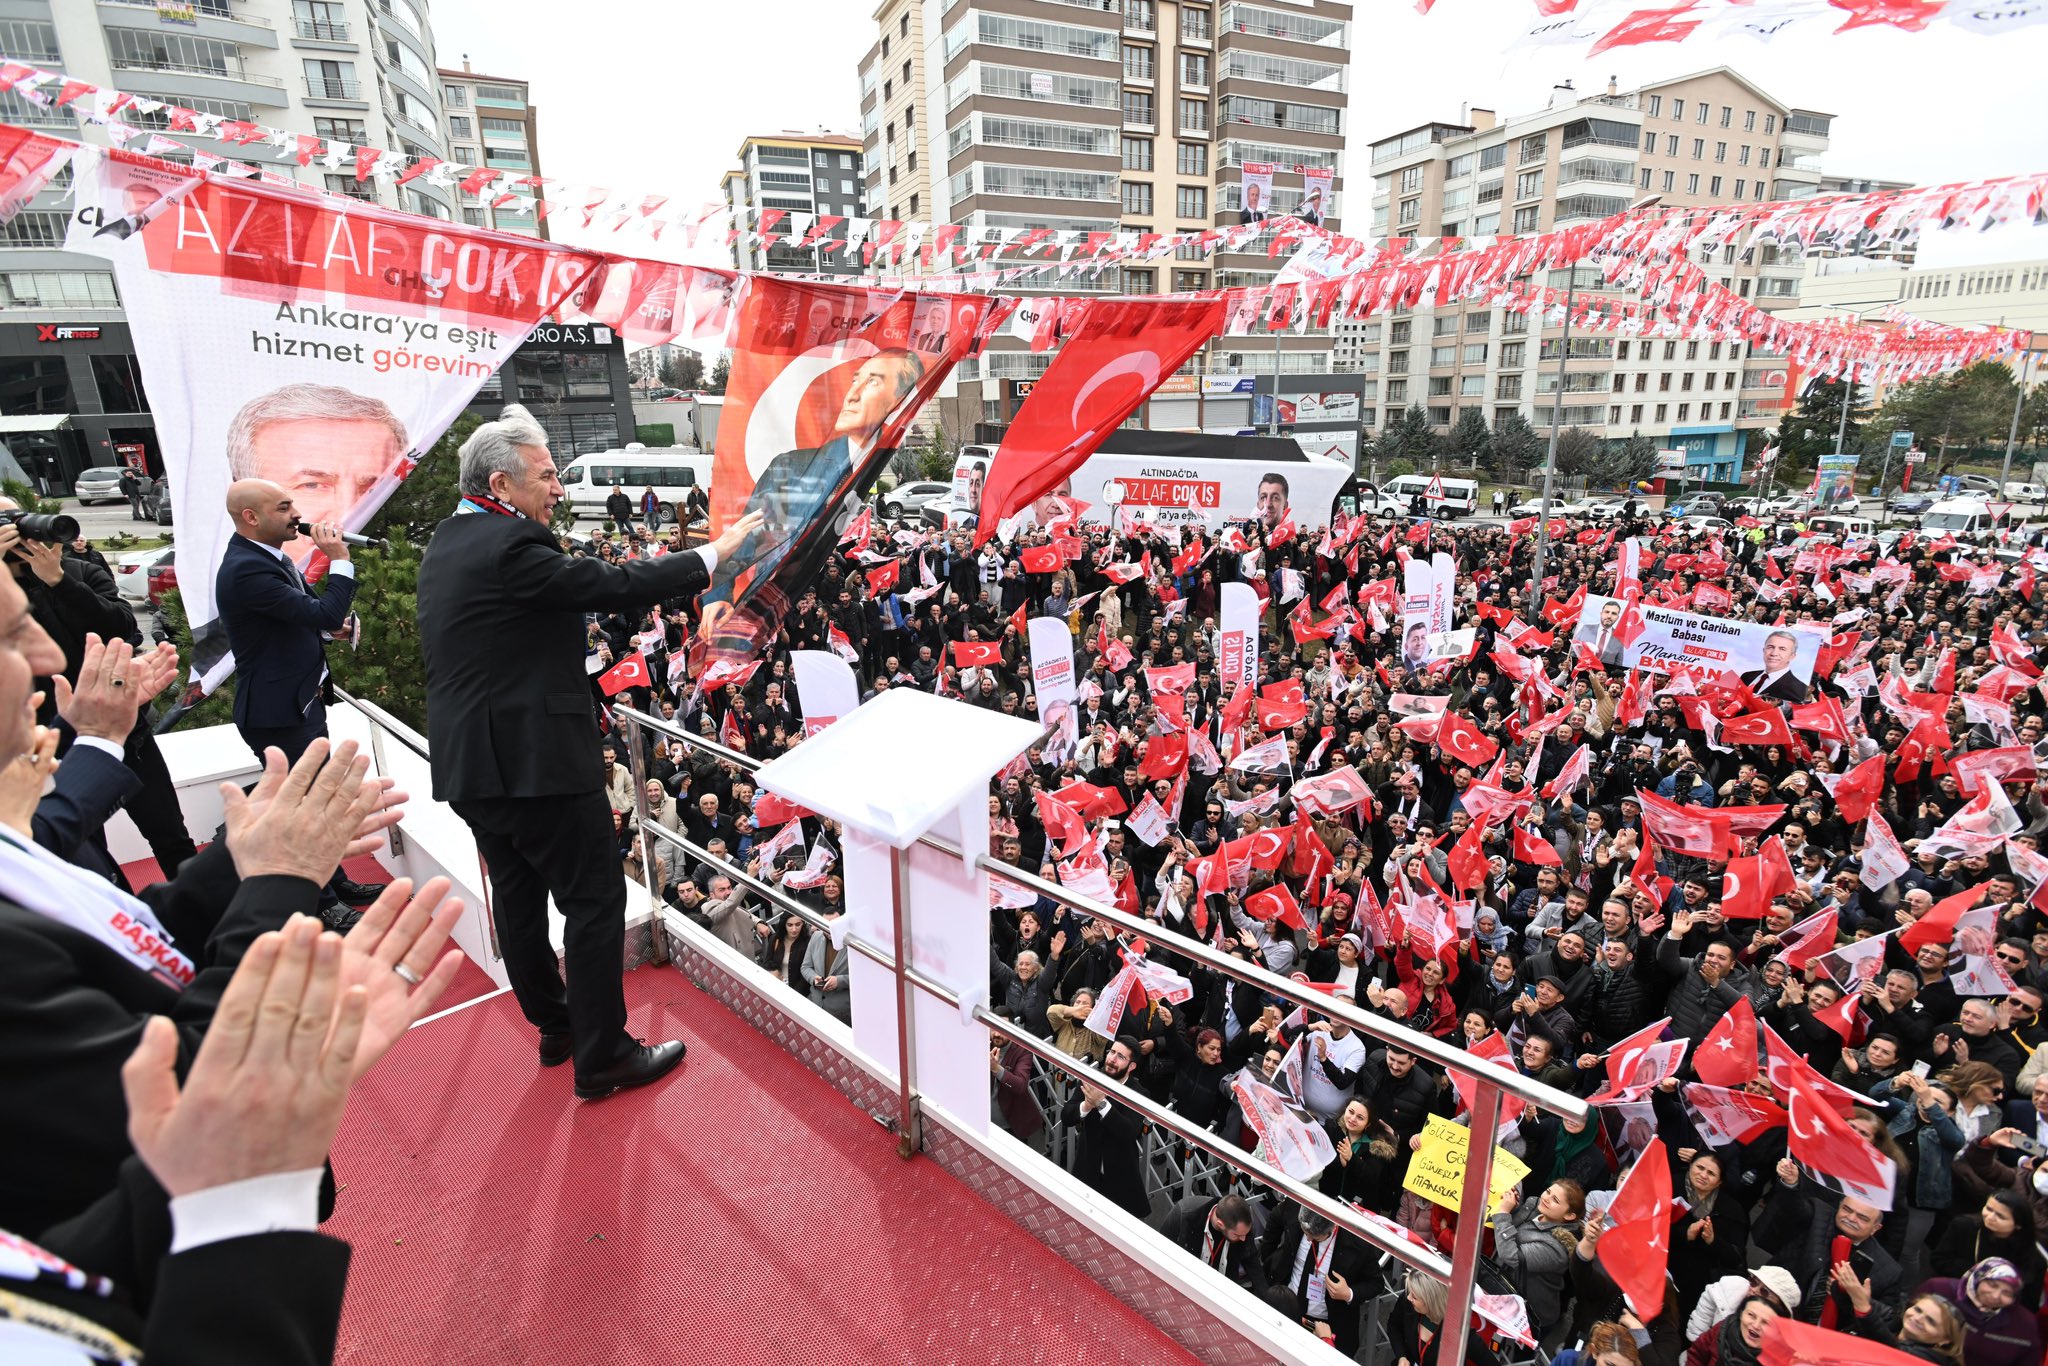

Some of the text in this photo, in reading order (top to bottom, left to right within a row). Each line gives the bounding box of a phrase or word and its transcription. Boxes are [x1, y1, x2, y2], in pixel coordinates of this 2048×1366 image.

[177, 191, 263, 260] AZ
[419, 234, 521, 299] ÇOK
[637, 303, 673, 321] CHP
[831, 316, 860, 330] CHP
[1020, 309, 1040, 324] CHP
[275, 300, 498, 353] Ankara'ya eşit
[564, 328, 590, 345] A.Ş.
[883, 328, 908, 340] CHP
[252, 330, 501, 379] hizmet görevim
[1140, 468, 1199, 479] ALTINDAĞ'DA
[1142, 483, 1169, 504] LAF,
[1173, 484, 1199, 505] ÇOK
[1202, 484, 1214, 506] İŞ
[1645, 610, 1742, 637] Mazlum ve Gariban
[1671, 628, 1706, 644] Babası
[1637, 640, 1701, 665] Mansur
[109, 911, 197, 986] BAŞKAN
[1427, 1123, 1468, 1147] GÜZE
[1412, 1174, 1459, 1202] MANSUR
